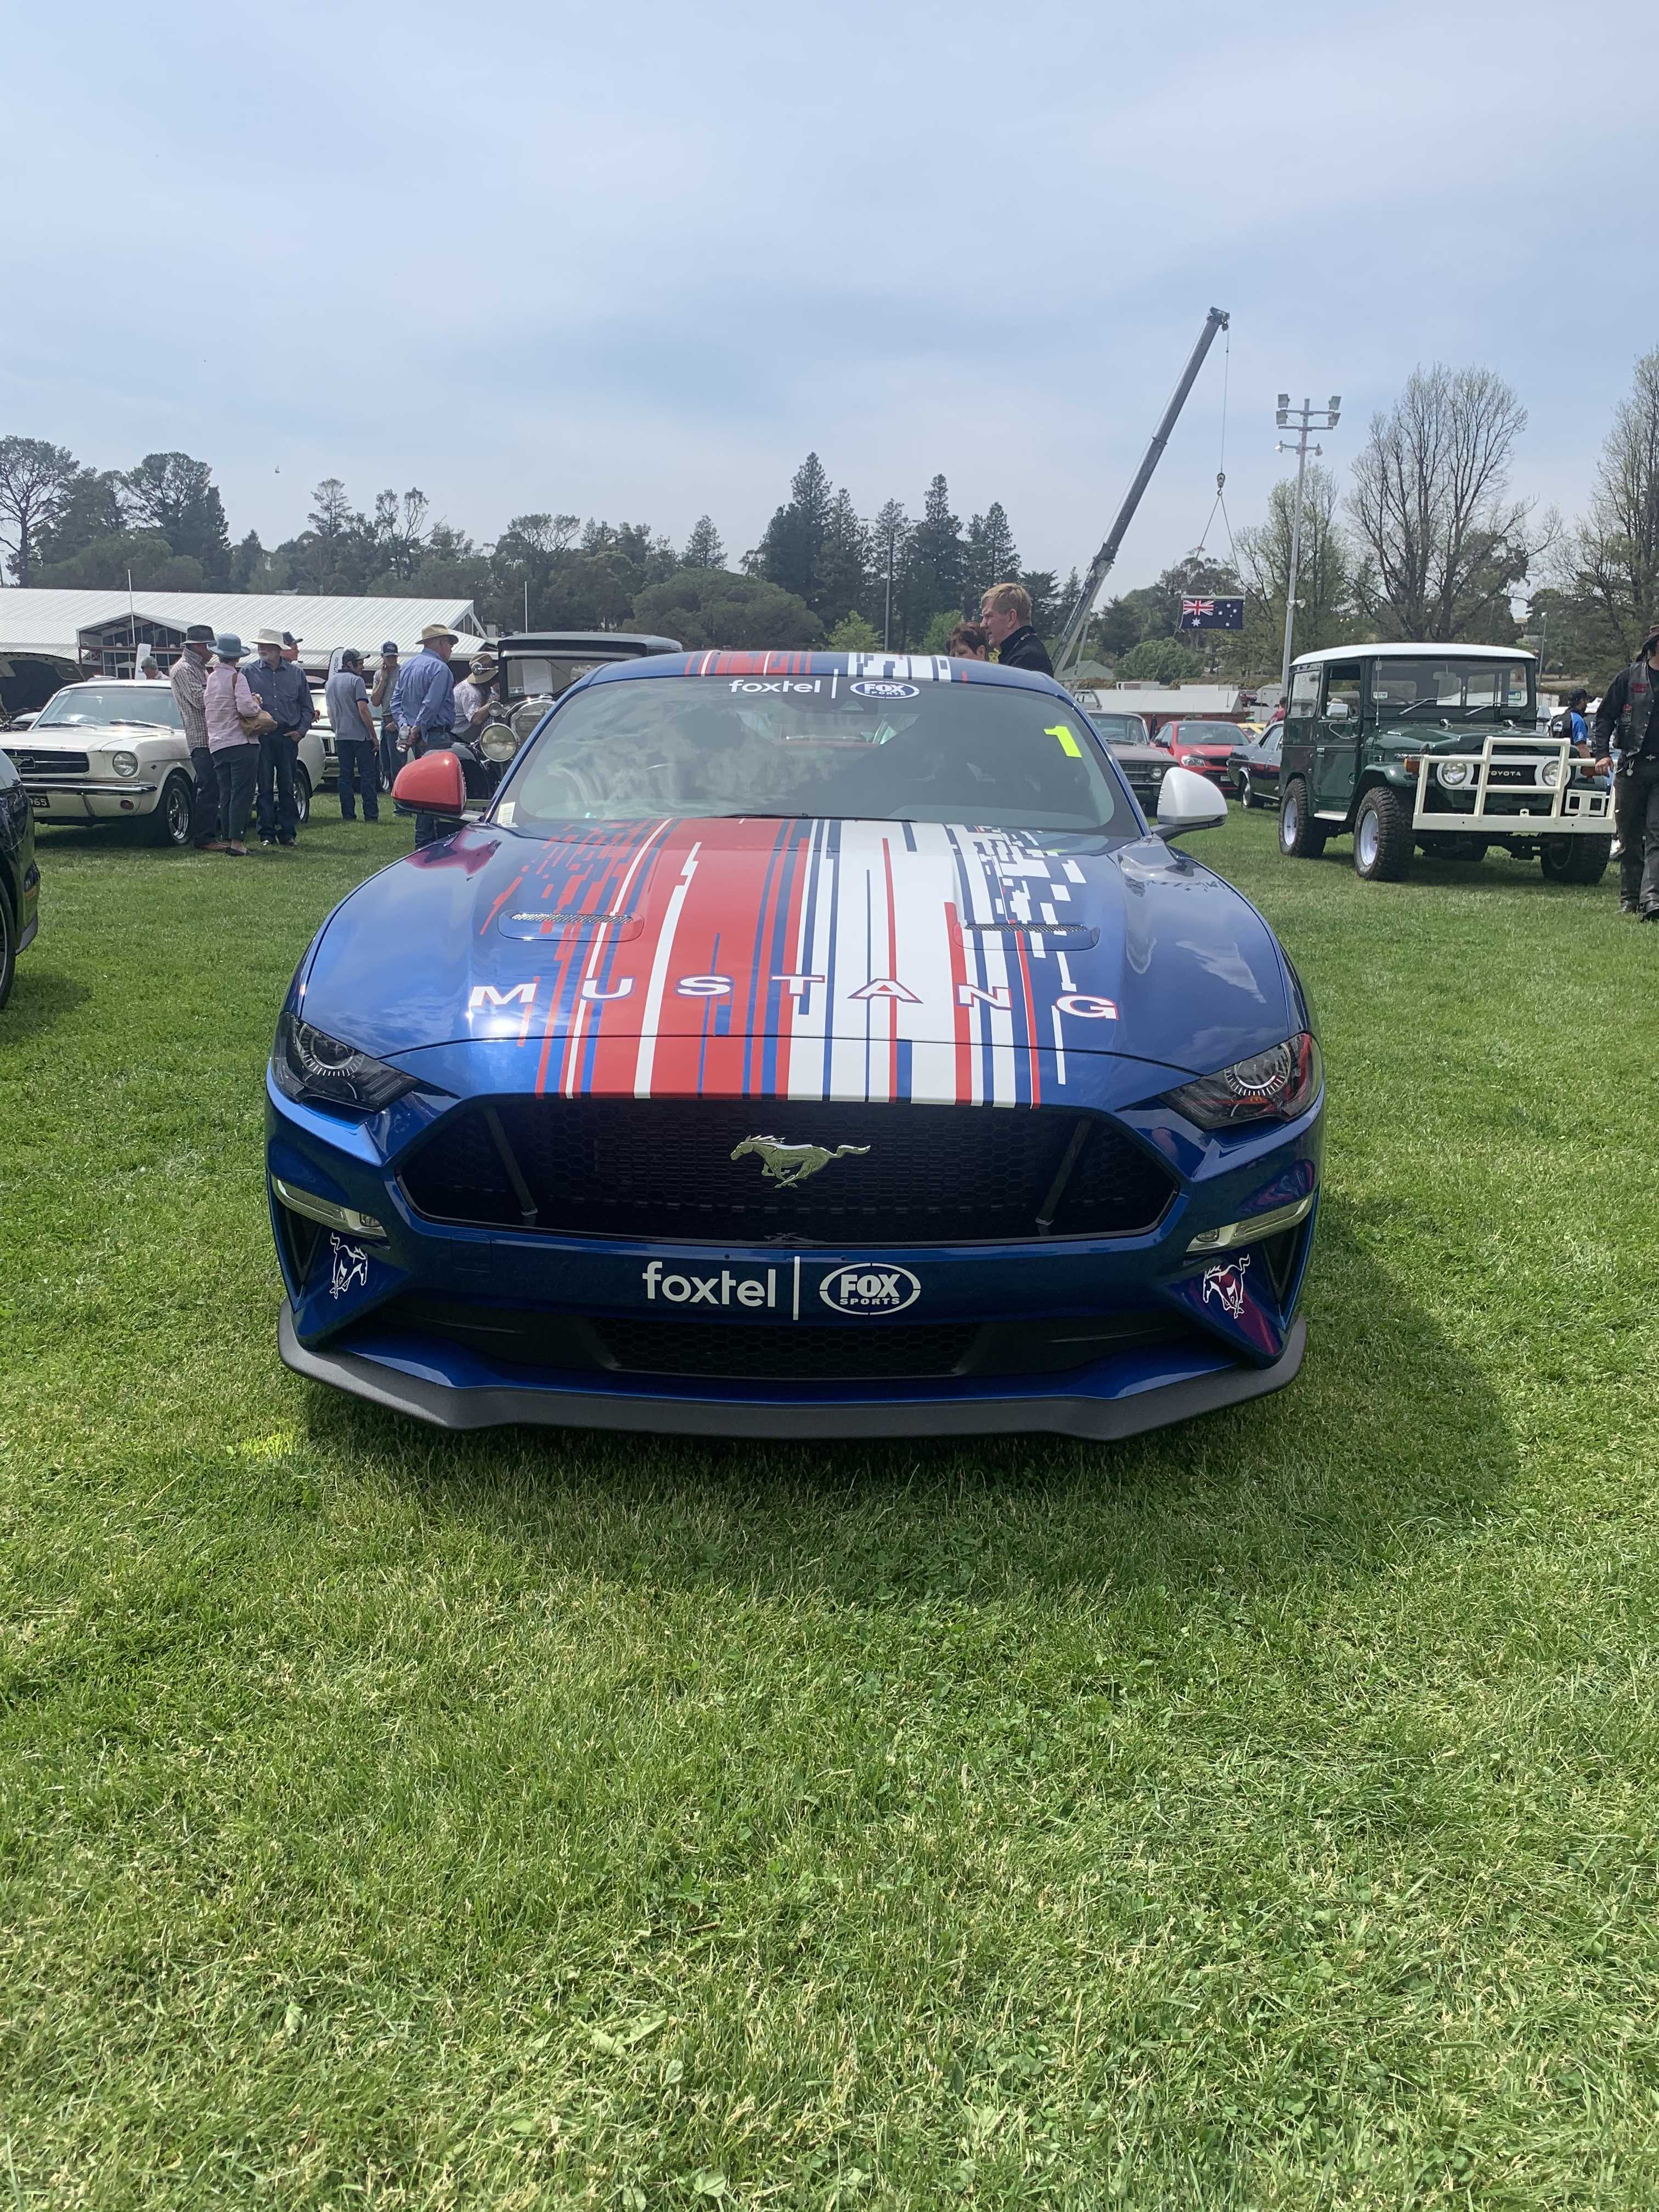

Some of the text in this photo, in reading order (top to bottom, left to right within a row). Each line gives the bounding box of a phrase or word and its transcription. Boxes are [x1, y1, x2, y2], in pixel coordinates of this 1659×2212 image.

[729, 679, 821, 693] foxtel
[864, 684, 905, 693] FOX
[1043, 725, 1082, 758] 1
[470, 974, 1119, 1020] MUSTANG
[642, 1261, 776, 1308] foxtel
[840, 1274, 901, 1298] FOX
